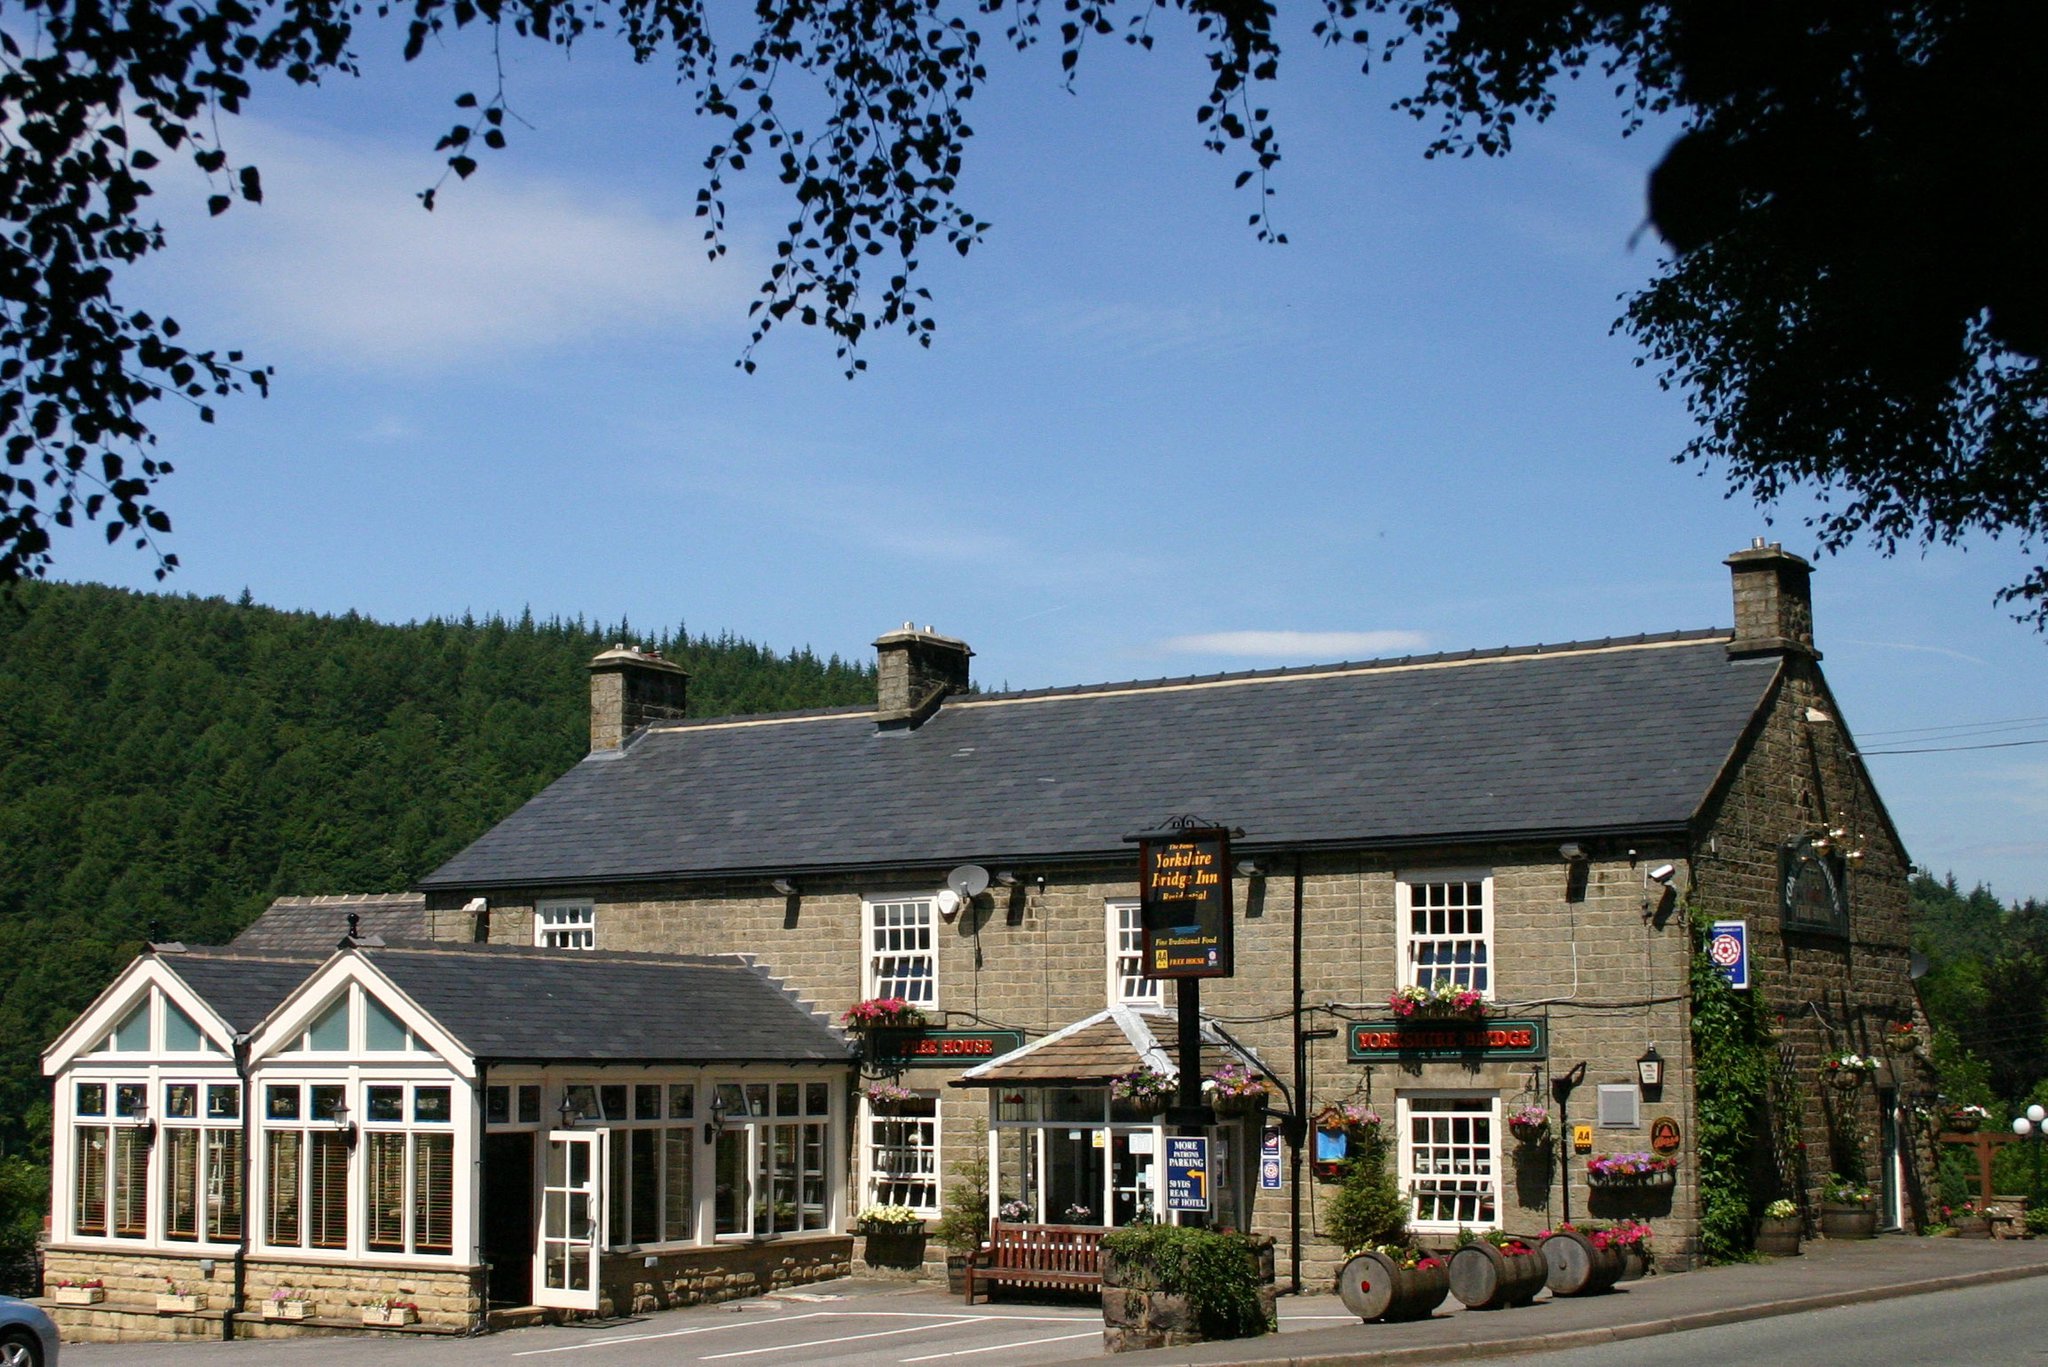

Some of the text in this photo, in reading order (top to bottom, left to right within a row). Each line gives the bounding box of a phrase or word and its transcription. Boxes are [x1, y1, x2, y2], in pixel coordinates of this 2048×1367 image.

[1156, 851, 1212, 868] Yorkshire
[1152, 870, 1218, 888] Bridge Inn
[1155, 936, 1217, 946] Fine Traditional Food
[1169, 958, 1186, 966] FREE
[1186, 957, 1205, 965] HOUSE
[1358, 1030, 1531, 1048] YORKSHIRE BRIDGE
[942, 1039, 993, 1055] HOUSE
[1576, 1131, 1590, 1141] AA
[1174, 1141, 1198, 1150] MORE
[1169, 1158, 1204, 1167] PARKING
[1169, 1189, 1189, 1197] REAR
[1169, 1198, 1205, 1207] OF HOTEL
